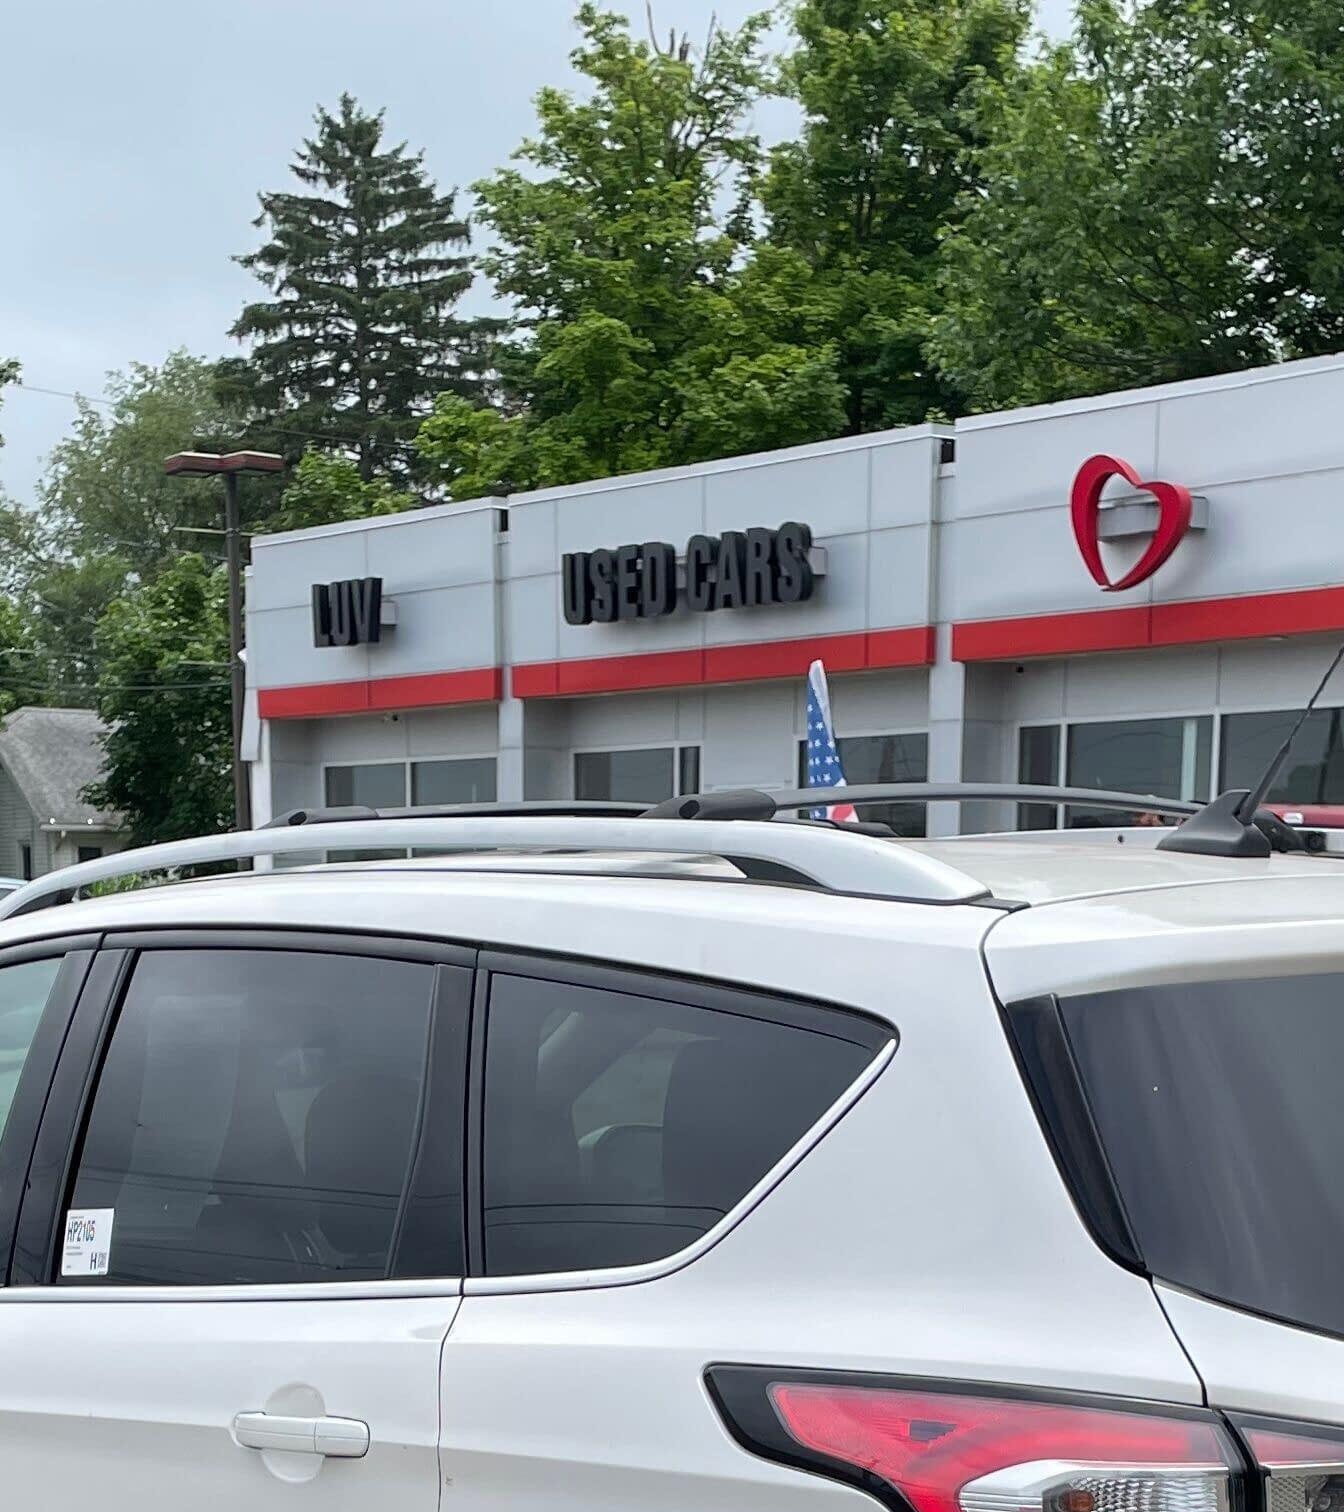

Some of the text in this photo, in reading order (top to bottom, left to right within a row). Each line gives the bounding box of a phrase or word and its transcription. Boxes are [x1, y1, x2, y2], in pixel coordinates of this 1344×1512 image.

[312, 576, 383, 648] LUV
[562, 521, 813, 625] USED CARS
